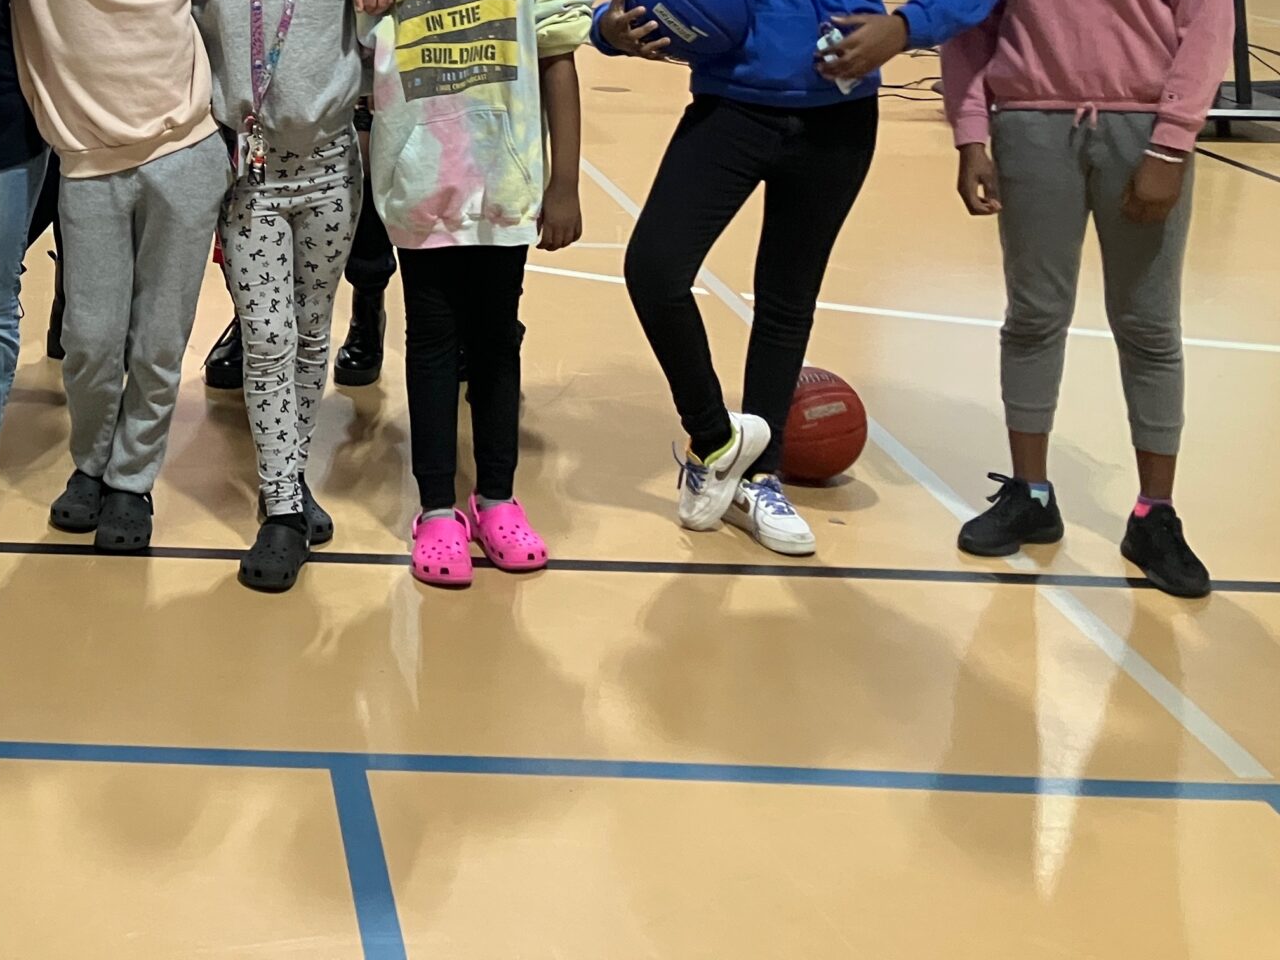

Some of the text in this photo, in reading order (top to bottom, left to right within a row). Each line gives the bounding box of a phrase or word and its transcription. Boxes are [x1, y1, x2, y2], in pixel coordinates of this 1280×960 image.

[425, 5, 481, 32] IN THE
[421, 44, 496, 65] BUILDING
